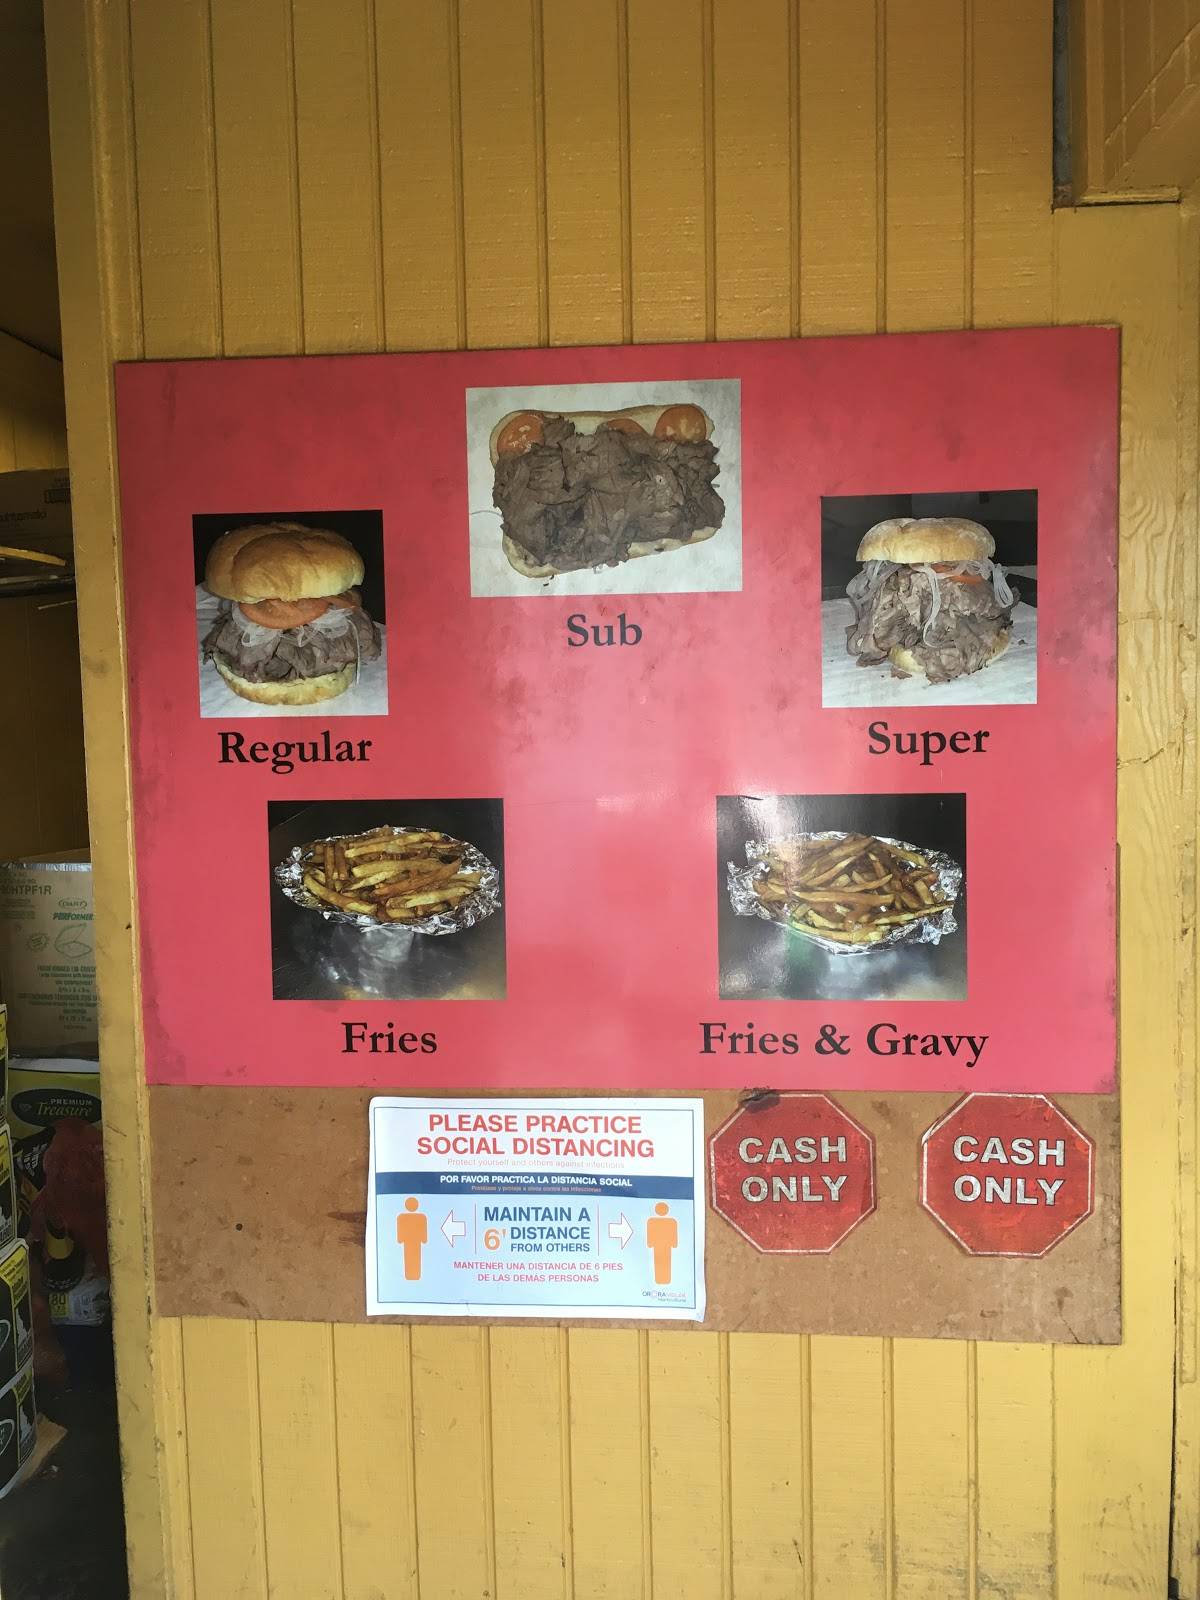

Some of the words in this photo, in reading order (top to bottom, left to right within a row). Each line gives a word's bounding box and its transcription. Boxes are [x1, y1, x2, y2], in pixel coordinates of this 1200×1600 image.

[567, 613, 642, 647] Sub
[217, 730, 372, 775] Regular
[868, 721, 990, 766] Super
[342, 1022, 437, 1054] Fries
[700, 1022, 798, 1055] Fries
[815, 1024, 850, 1055] &
[867, 1023, 989, 1068] Gravy
[50, 1098, 92, 1106] PREMIUM
[429, 1114, 518, 1132] PLEASE
[526, 1115, 642, 1134] PRACTICE
[417, 1137, 505, 1154] SOCIAL
[513, 1138, 655, 1157] DISTANCING
[738, 1136, 847, 1164] CASH
[953, 1135, 1065, 1166] CASH
[447, 1158, 476, 1166] Protect
[478, 1159, 509, 1167] yourself
[528, 1159, 553, 1167] others
[556, 1160, 584, 1169] against
[587, 1161, 625, 1169] infections
[440, 1175, 459, 1183] POR
[461, 1175, 490, 1184] FAVOR
[492, 1175, 535, 1184] PRACTICA
[537, 1176, 549, 1184] LA
[551, 1176, 597, 1185] DISTANCIA
[600, 1178, 633, 1187] SOCIAL
[741, 1175, 847, 1202] ONLY
[953, 1174, 1065, 1206] ONLY
[484, 1207, 571, 1221] MAINTAIN
[578, 1207, 591, 1221] A
[484, 1228, 506, 1250] 6'
[510, 1226, 590, 1240] DISTANCE
[511, 1243, 542, 1252] FROM
[546, 1243, 590, 1252] OTHERS
[454, 1261, 503, 1270] MANTENER
[507, 1262, 525, 1270] UNA
[528, 1262, 576, 1270] DISTANCIA
[580, 1262, 592, 1270] DE
[478, 1273, 490, 1281] DE
[548, 1274, 599, 1282] PERSONAS
